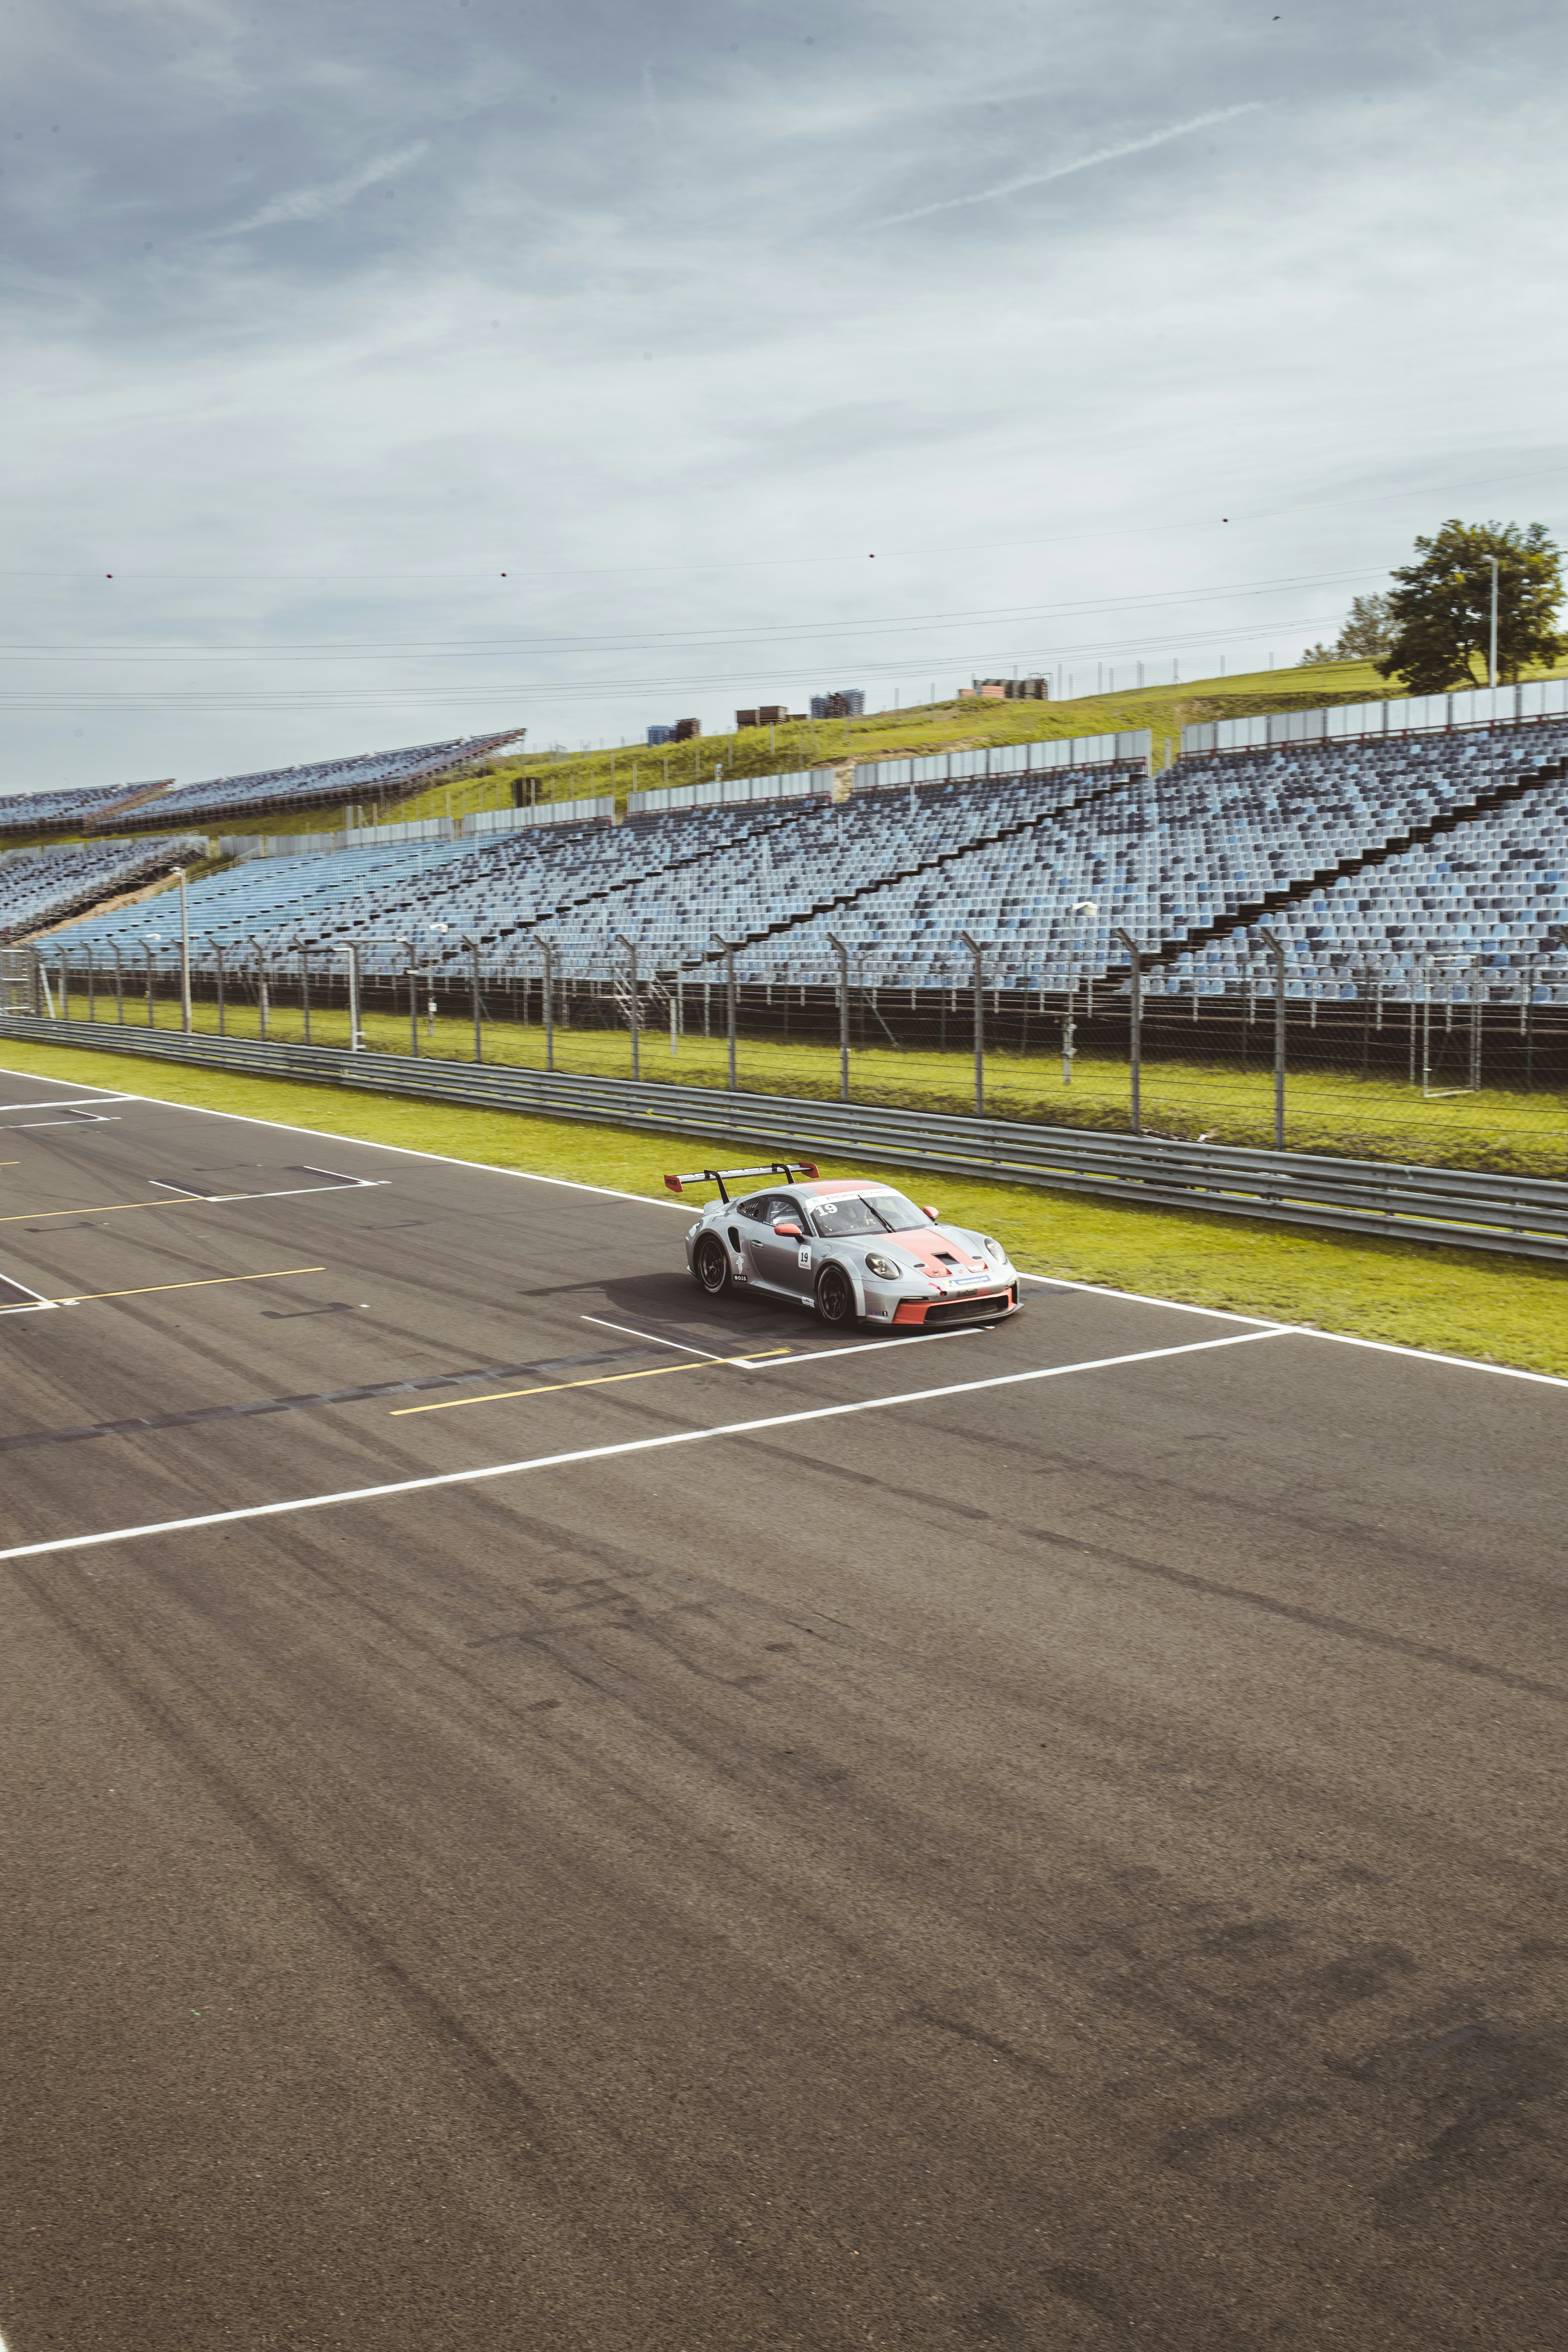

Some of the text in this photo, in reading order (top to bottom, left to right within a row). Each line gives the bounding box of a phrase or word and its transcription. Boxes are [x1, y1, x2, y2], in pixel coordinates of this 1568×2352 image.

[826, 1191, 887, 1200] PORSCHE
[815, 1204, 838, 1216] 19
[801, 1252, 808, 1262] 19
